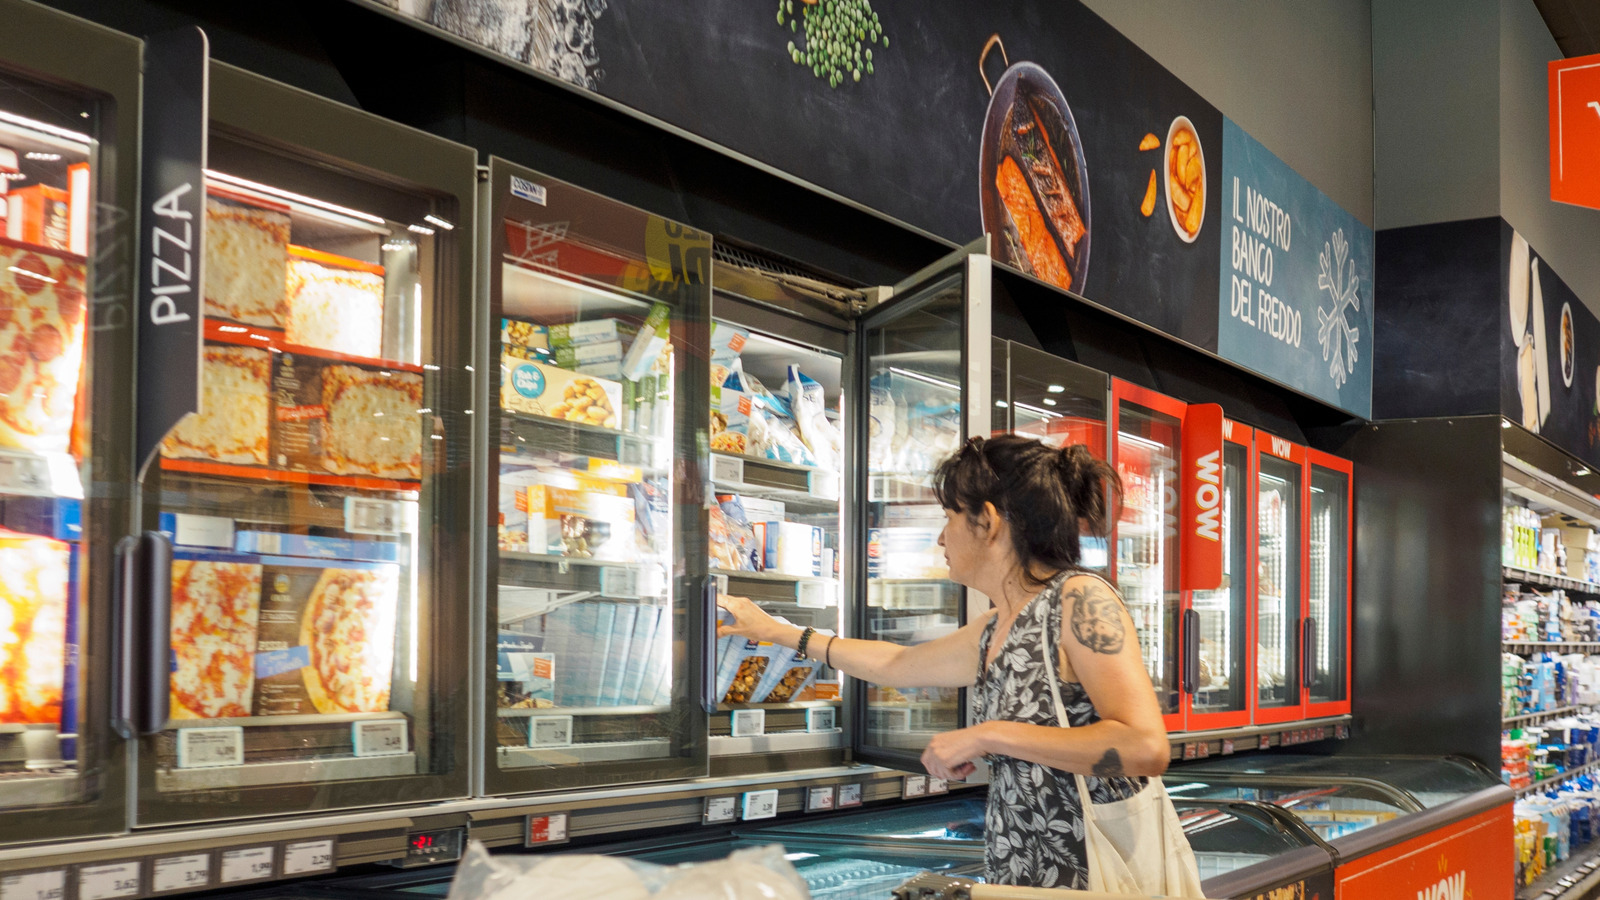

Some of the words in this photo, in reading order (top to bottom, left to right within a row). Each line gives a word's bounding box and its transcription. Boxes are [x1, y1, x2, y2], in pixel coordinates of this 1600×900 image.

[1232, 175, 1244, 223] IL
[1246, 185, 1291, 252] NOSTRO
[150, 182, 193, 326] PIZZA
[1232, 225, 1273, 287] BANCO
[1231, 274, 1256, 327] DEL
[1257, 288, 1301, 349] FREDDO
[1271, 436, 1291, 459] WOW
[1195, 450, 1220, 542] WOW
[412, 835, 432, 849] -21
